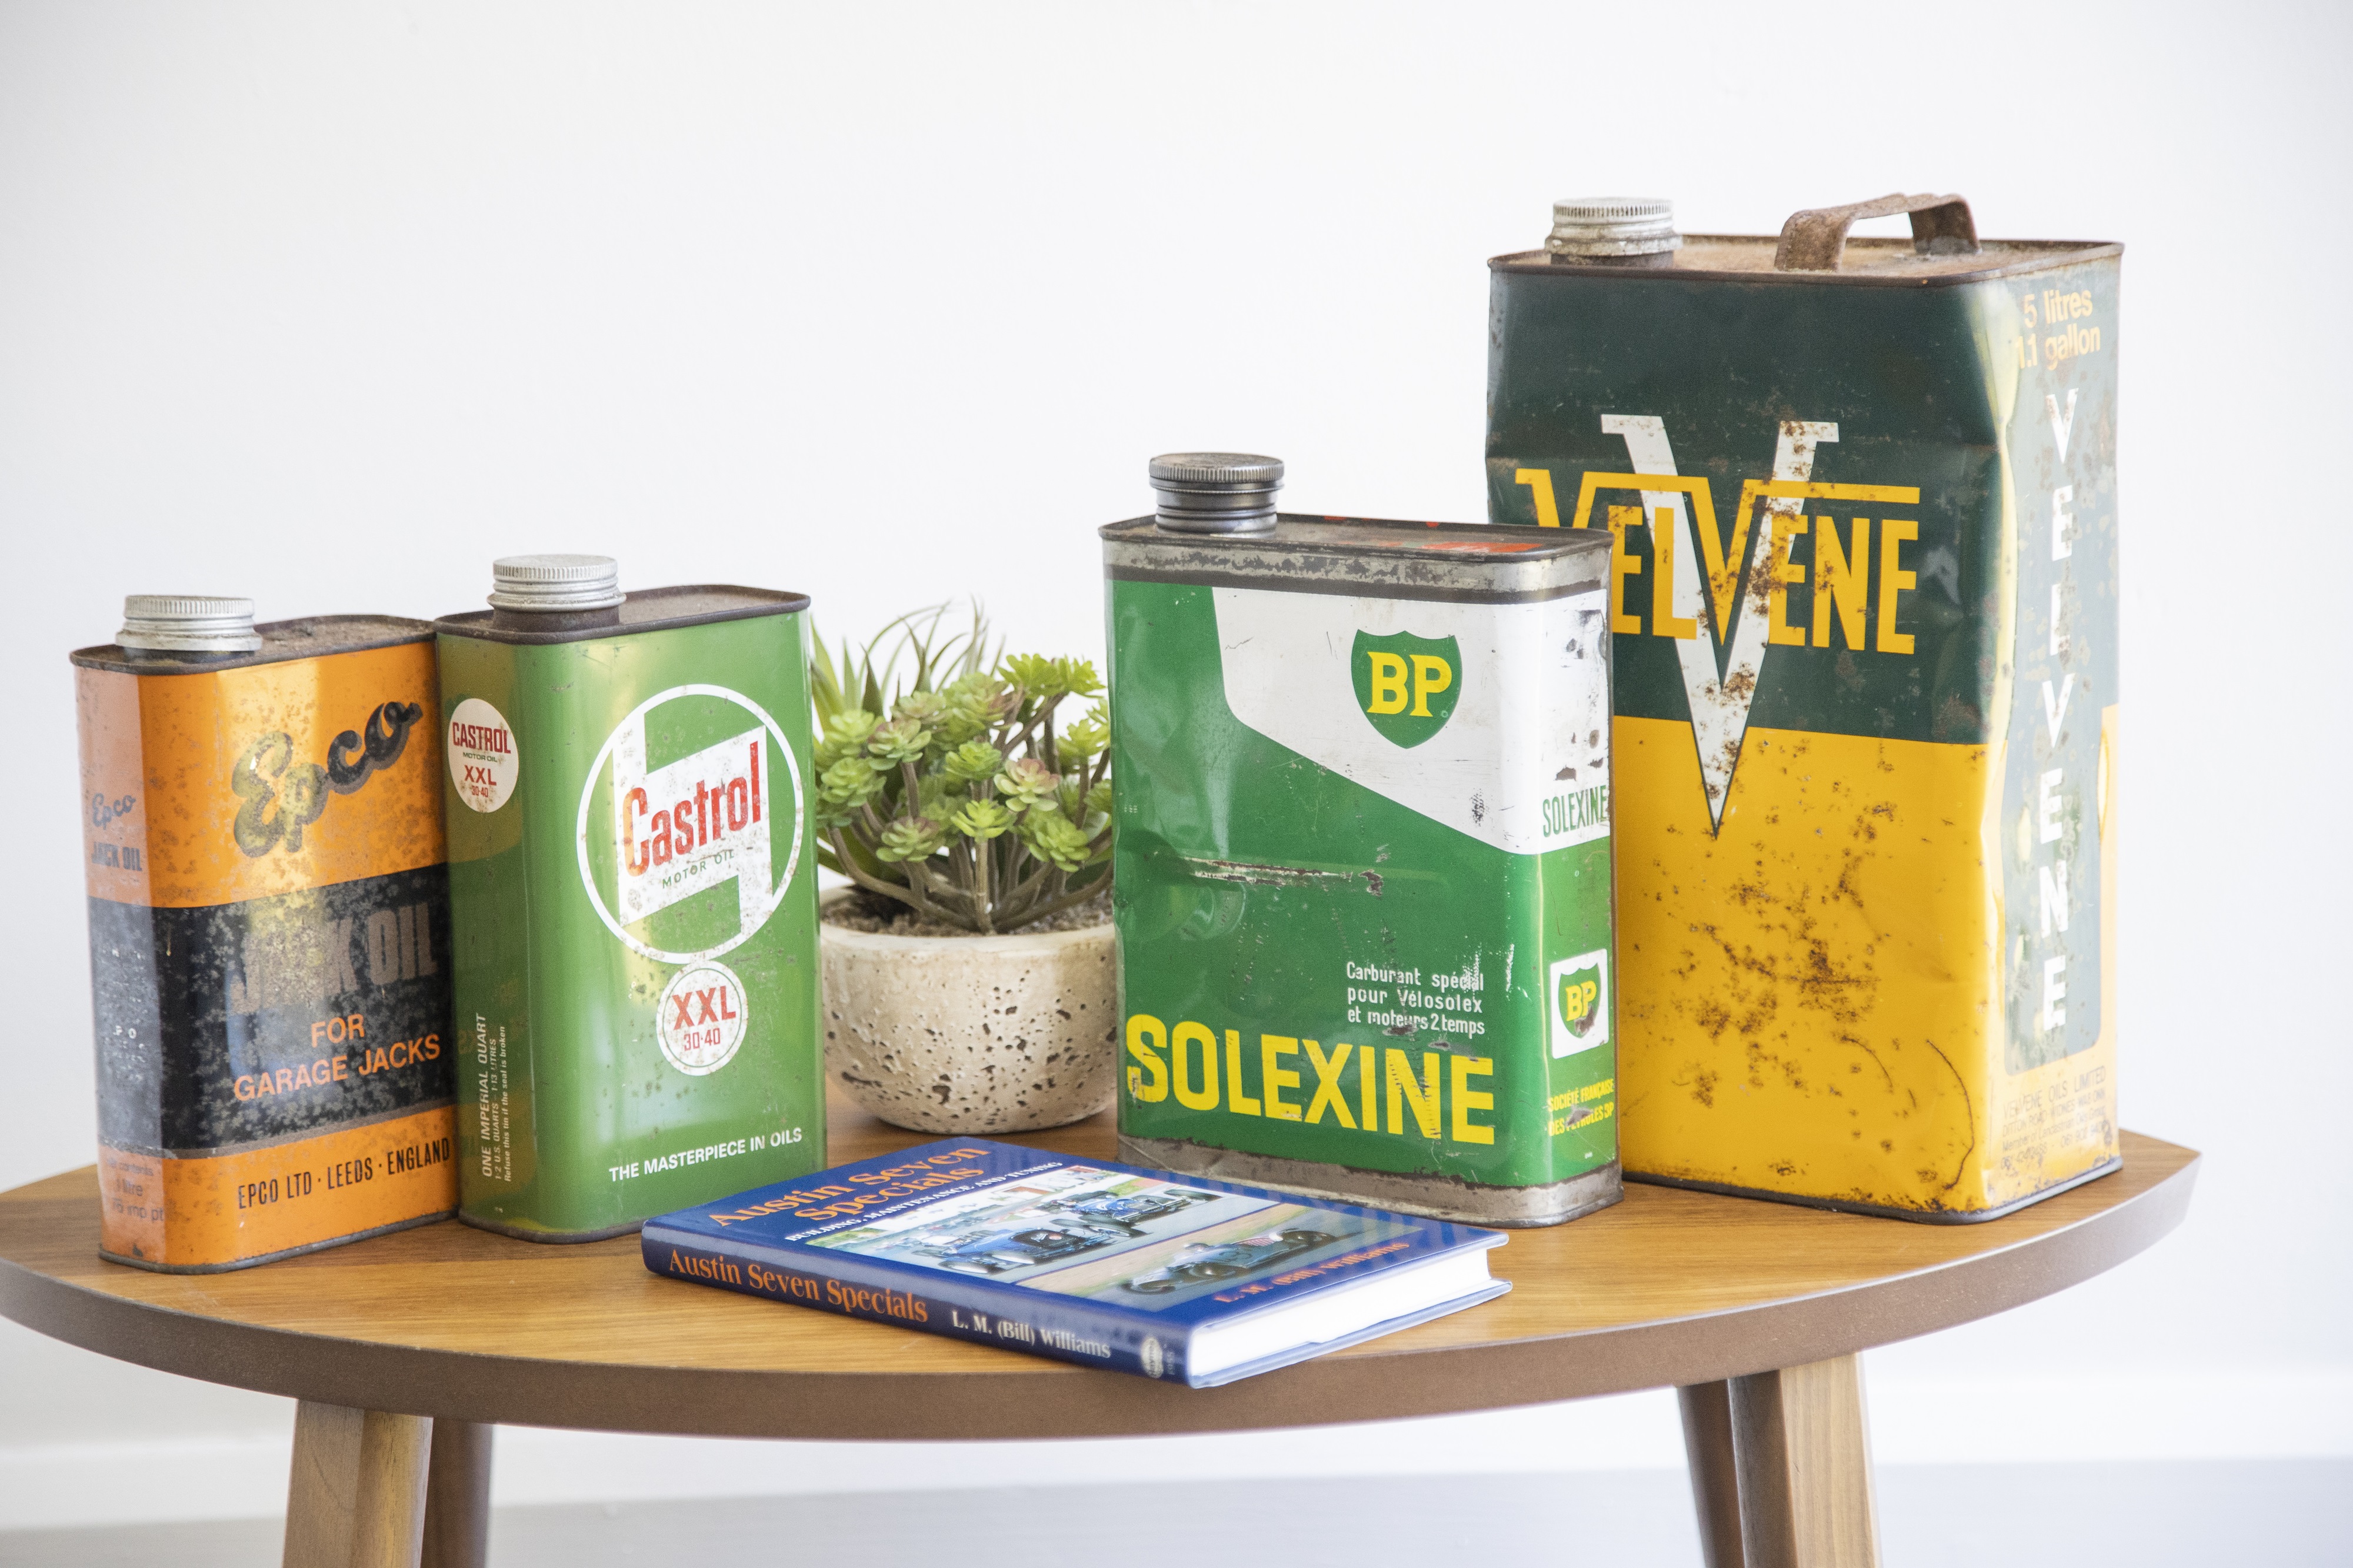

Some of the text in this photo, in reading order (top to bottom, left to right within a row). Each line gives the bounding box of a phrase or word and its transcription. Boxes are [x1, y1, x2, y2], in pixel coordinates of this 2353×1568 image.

[2024, 289, 2094, 329] 5 litres
[2044, 323, 2101, 371] gallon
[1366, 651, 1453, 718] BP
[452, 722, 512, 754] CASTROL
[462, 752, 486, 762] MOTOR
[232, 700, 423, 859] Epco
[464, 764, 497, 786] XXL
[91, 792, 136, 830] Epco
[622, 740, 762, 877] Castrol
[1542, 784, 1609, 838] SOLEXINE
[122, 846, 143, 872] OIL
[662, 850, 736, 889] MOTOR OIL
[368, 902, 439, 986] OIL
[1347, 960, 1422, 986] Carburant
[671, 985, 736, 1030] XXL
[1347, 1005, 1361, 1023] et
[1367, 1009, 1429, 1030] moteurs
[1348, 986, 1483, 1013] pour Vélosolex
[1565, 980, 1597, 1022] BP
[310, 1013, 365, 1048] FOR
[498, 1026, 506, 1057] broken
[234, 1034, 441, 1102] GARAGE JACKS
[489, 1039, 498, 1071] LITRES
[499, 1059, 507, 1068] is
[475, 1012, 493, 1177] ONE IMPERIAL QUART
[501, 1091, 509, 1106] the
[1125, 1013, 1495, 1146] SOLEXINE
[2048, 1080, 2068, 1103] OILS
[492, 1103, 501, 1142] QUARTS
[501, 1116, 509, 1129] tin
[502, 1132, 511, 1148] this
[1548, 1117, 1565, 1137] DES
[238, 1137, 451, 1210] EPCO LTD LEEDS ENGLAND
[502, 1150, 512, 1182] Refuse
[608, 1126, 803, 1182] THE MASTERPIECE IN OILS
[708, 1146, 992, 1227] Austin Seven
[794, 1165, 985, 1222] Specials
[864, 1185, 975, 1225] MAINTENANCE
[975, 1174, 1006, 1187] AND
[669, 1249, 929, 1323] Austin Seven Specials
[952, 1311, 1112, 1359] L. M. (Bill) Williams
